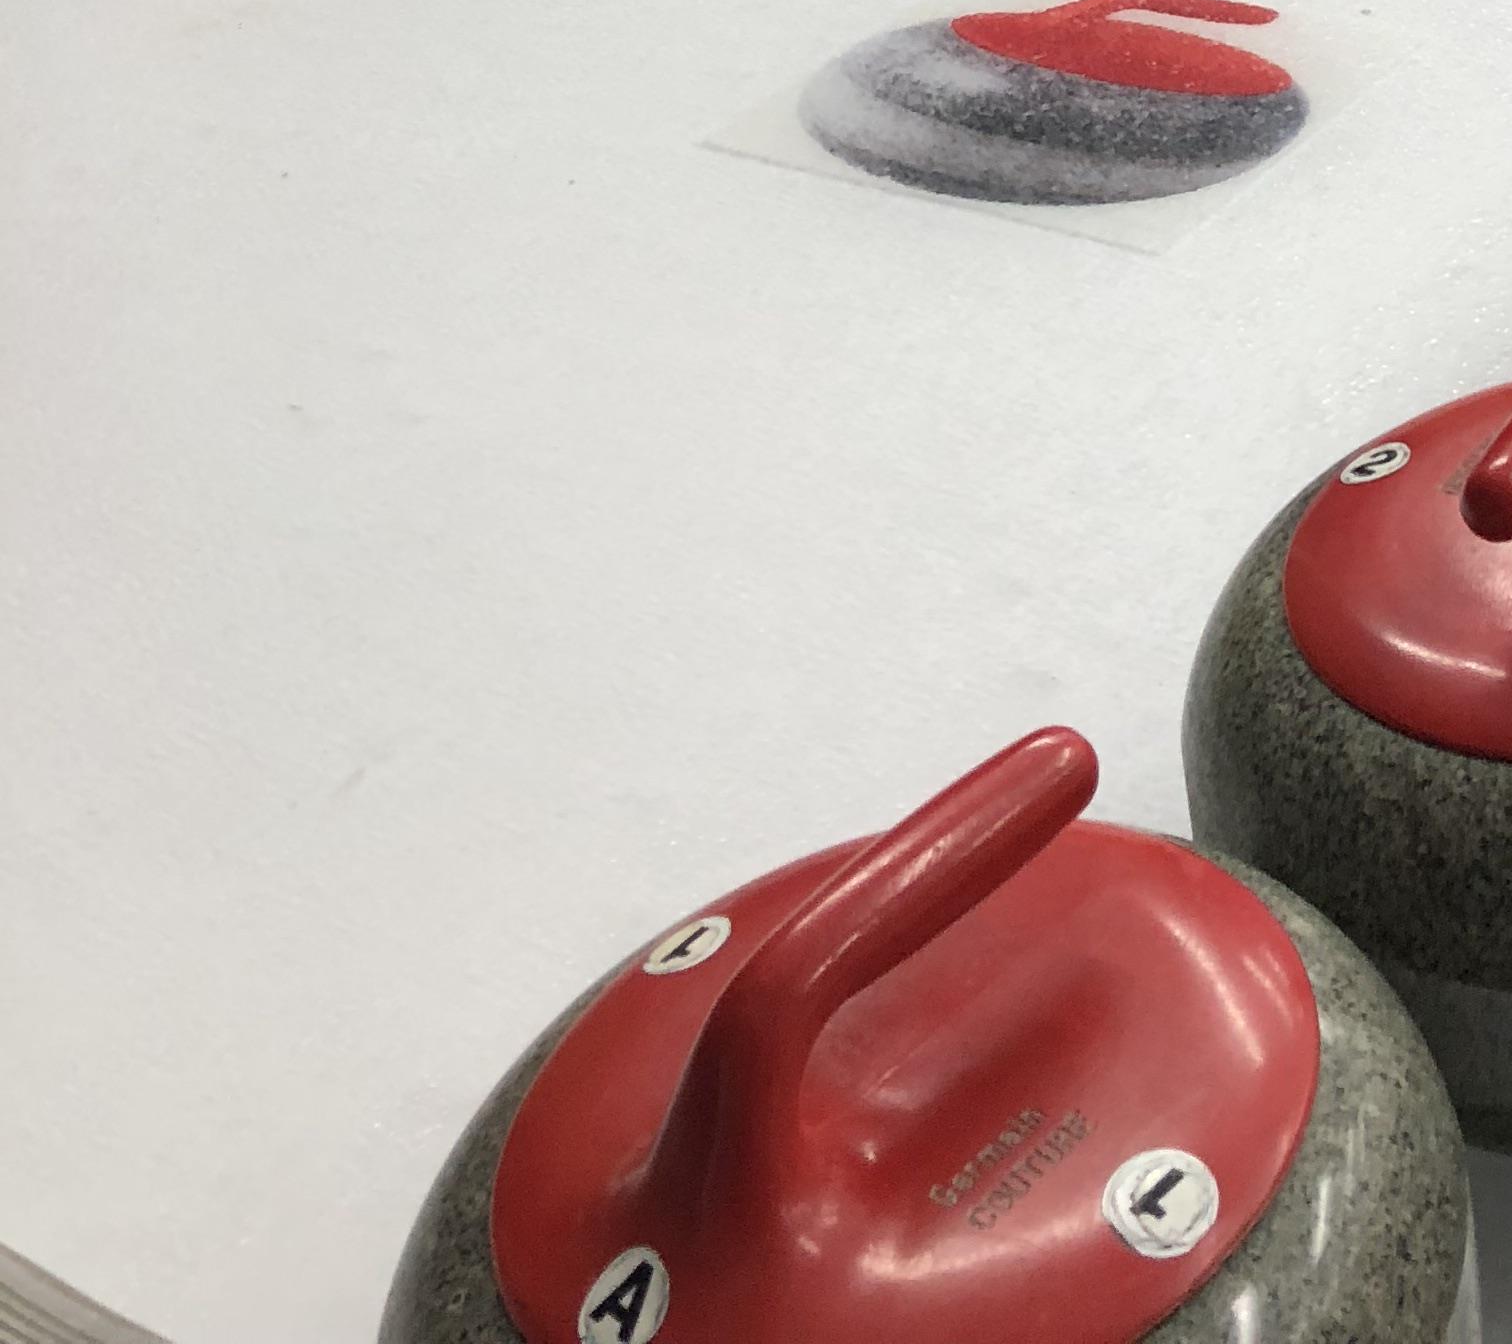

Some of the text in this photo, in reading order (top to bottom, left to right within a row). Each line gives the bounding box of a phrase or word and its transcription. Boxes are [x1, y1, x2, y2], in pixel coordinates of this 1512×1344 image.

[1354, 447, 1400, 480] 2
[660, 926, 710, 963] 1
[1130, 1167, 1185, 1220] 1
[588, 1259, 655, 1344] A
